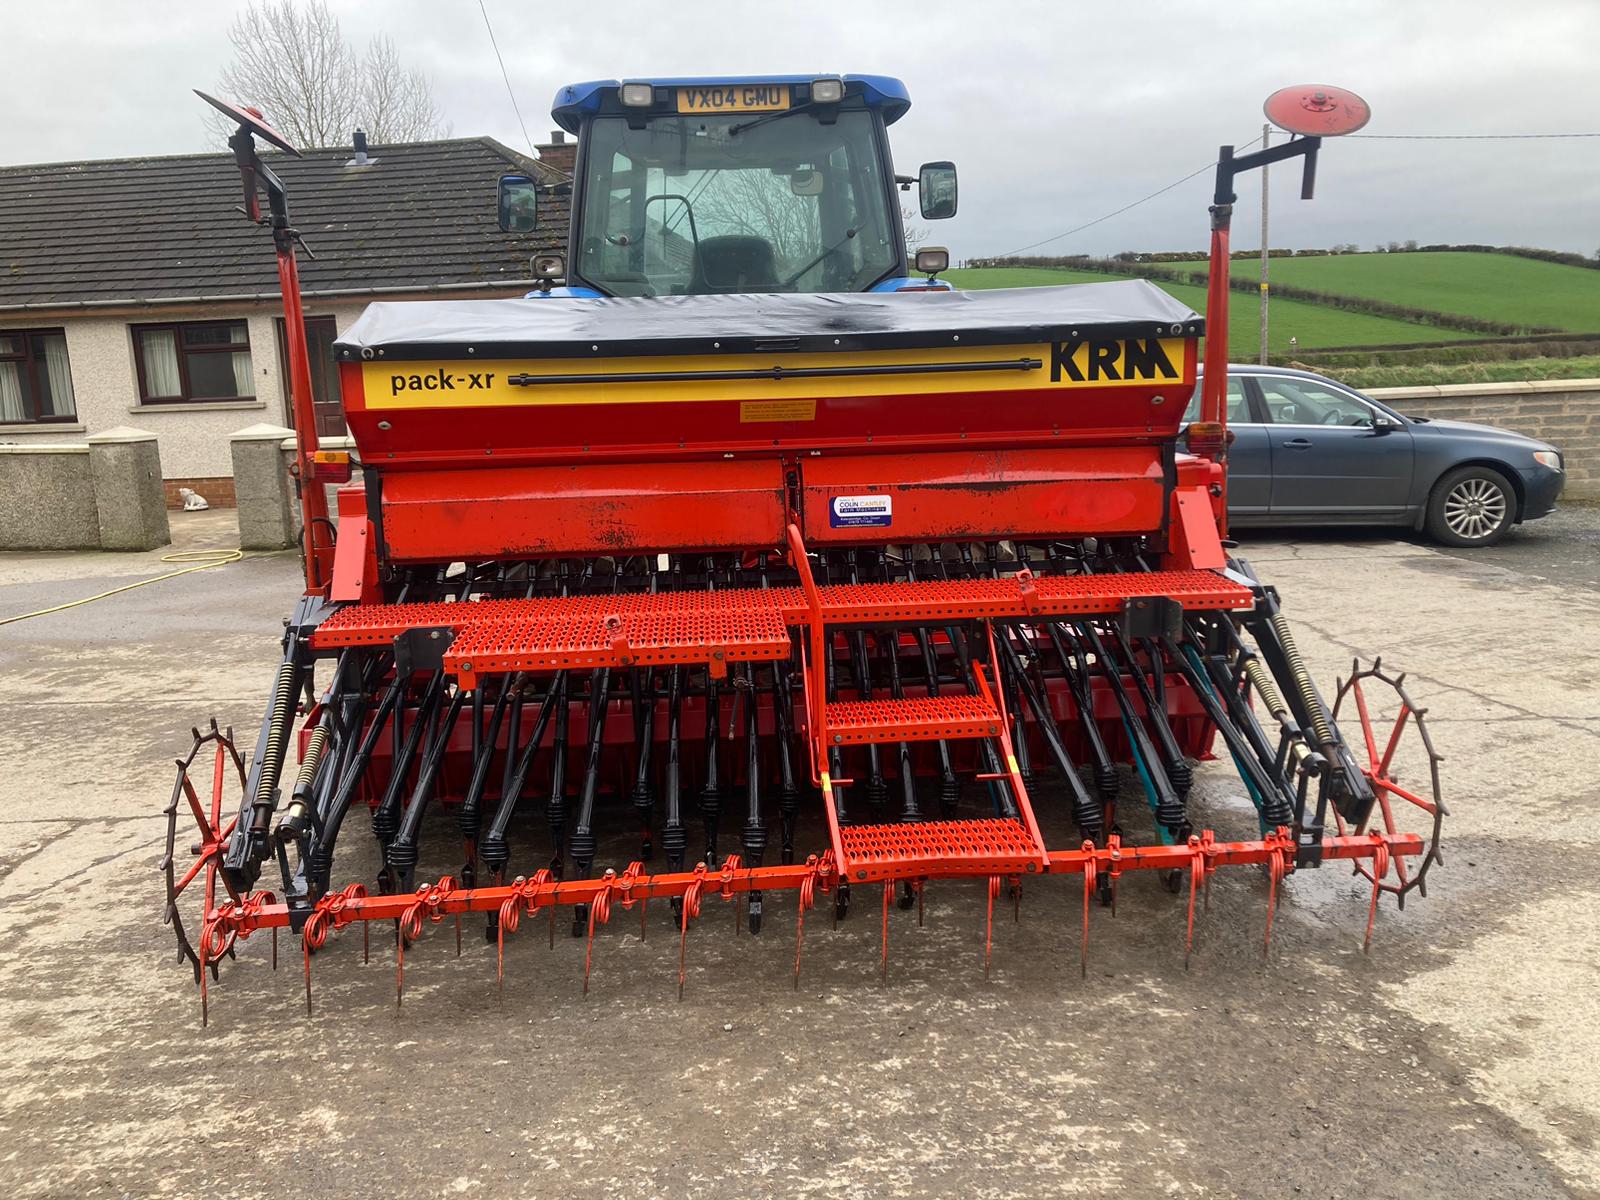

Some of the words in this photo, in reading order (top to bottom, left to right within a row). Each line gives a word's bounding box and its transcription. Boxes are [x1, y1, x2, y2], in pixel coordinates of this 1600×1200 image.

[686, 90, 736, 108] VX04
[743, 87, 781, 106] GMU
[1050, 338, 1179, 382] KRM
[391, 368, 495, 396] pack-xr
